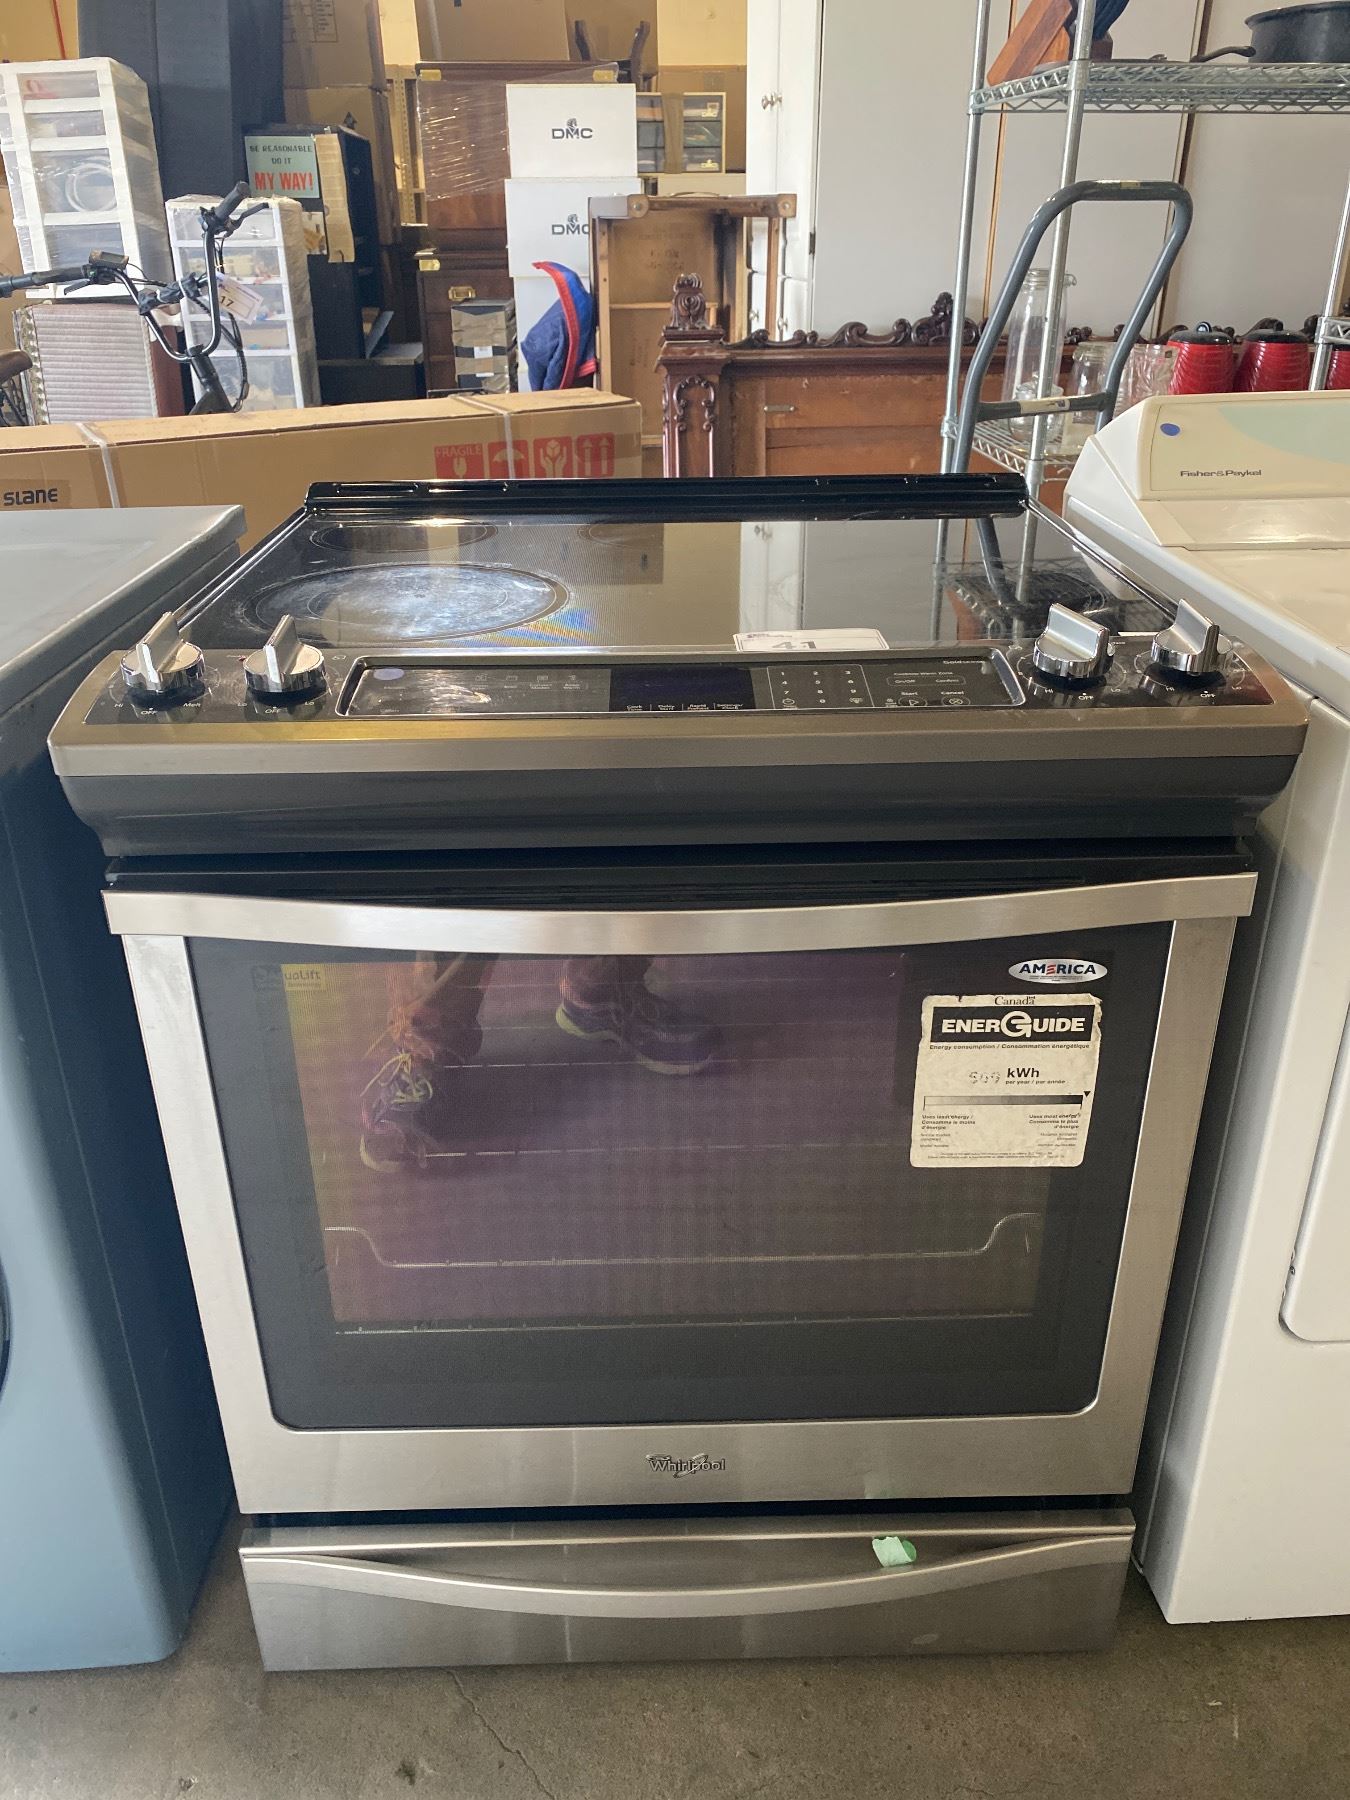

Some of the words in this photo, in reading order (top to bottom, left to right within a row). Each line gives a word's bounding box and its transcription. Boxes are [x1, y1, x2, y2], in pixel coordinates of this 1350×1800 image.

[551, 128, 593, 139] DMC
[262, 145, 313, 153] REASONABLE
[271, 157, 282, 165] DO
[284, 157, 292, 165] IT
[254, 172, 274, 191] MY
[279, 171, 314, 191] WAY!
[436, 445, 482, 457] FRAGILE
[1019, 963, 1097, 975] AMERICA
[995, 996, 1036, 1006] Canada
[941, 1010, 1086, 1038] ENERGUIDE
[1007, 1067, 1040, 1078] kWh
[647, 1454, 726, 1476] Whirlpool
